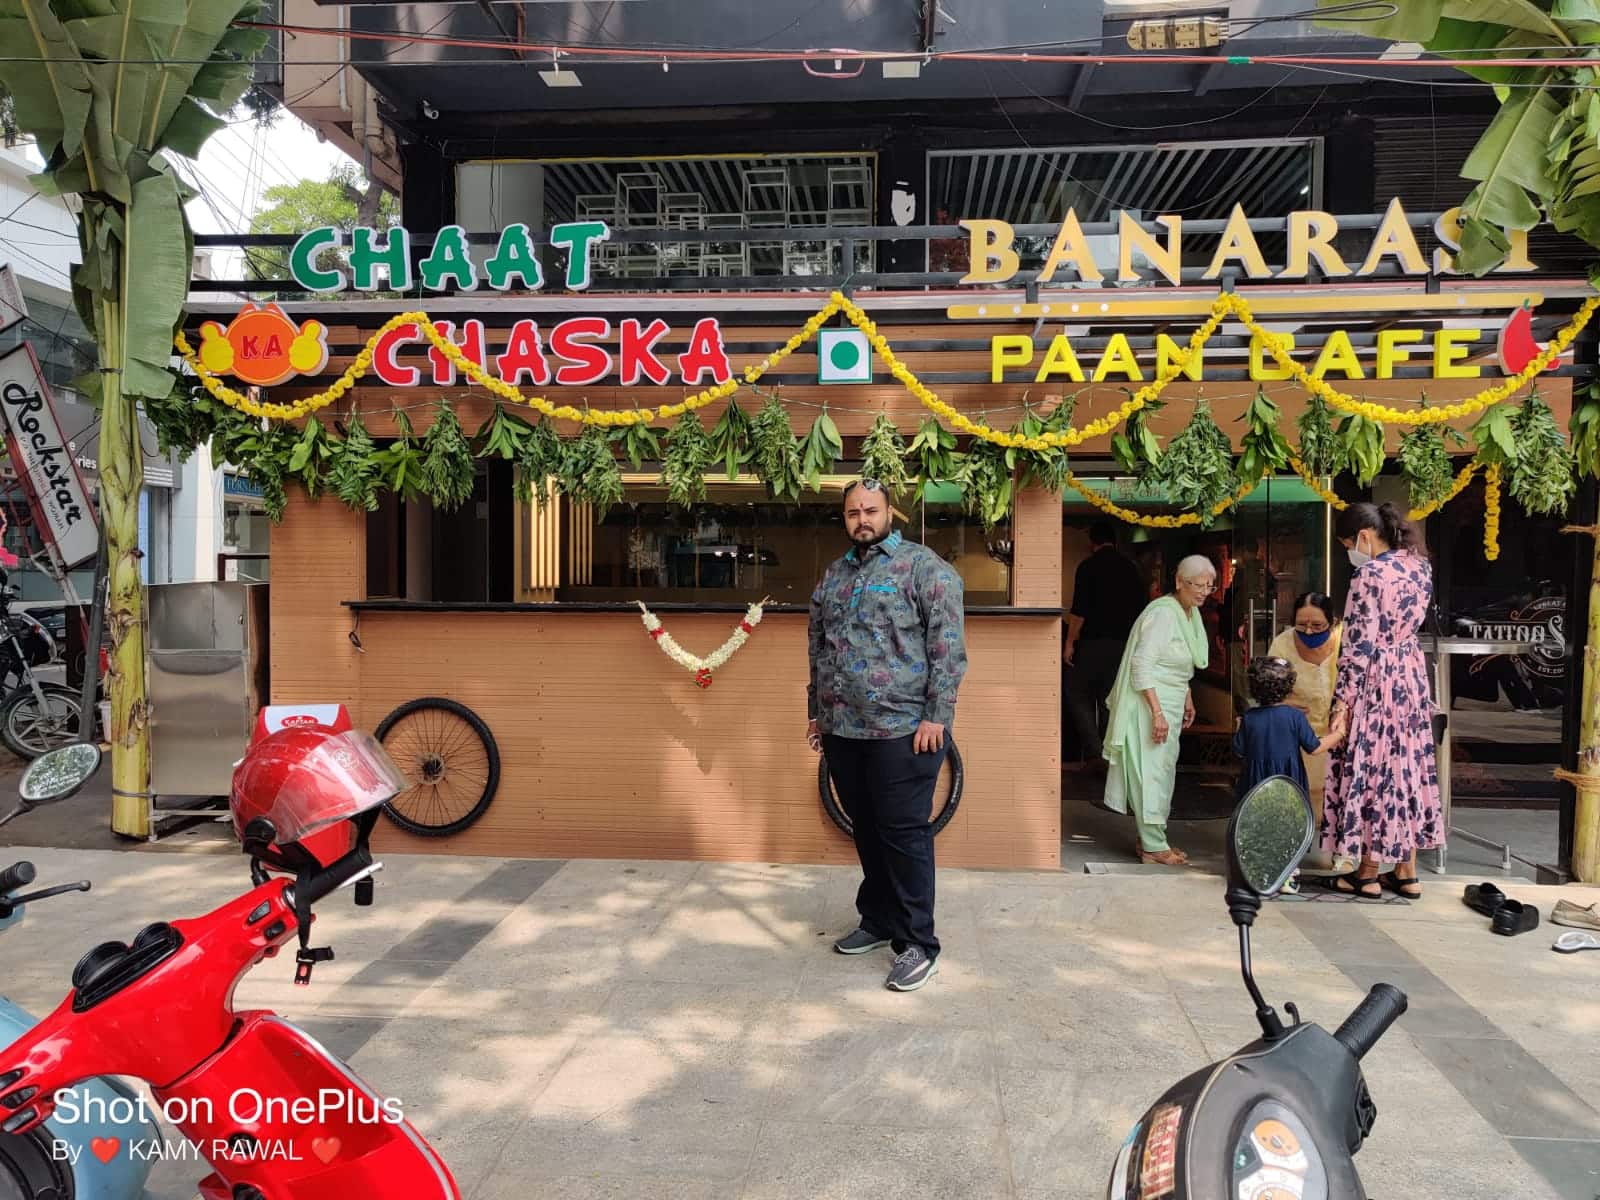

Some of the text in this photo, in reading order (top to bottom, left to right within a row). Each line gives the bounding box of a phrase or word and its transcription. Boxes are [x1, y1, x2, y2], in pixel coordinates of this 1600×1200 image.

[289, 220, 611, 293] CHAAT
[240, 334, 284, 361] KA
[372, 316, 734, 387] CHASKA
[991, 328, 1482, 384] PAAN CAFE
[3, 382, 82, 527] Rockstar
[1468, 615, 1566, 660] TATTOOS
